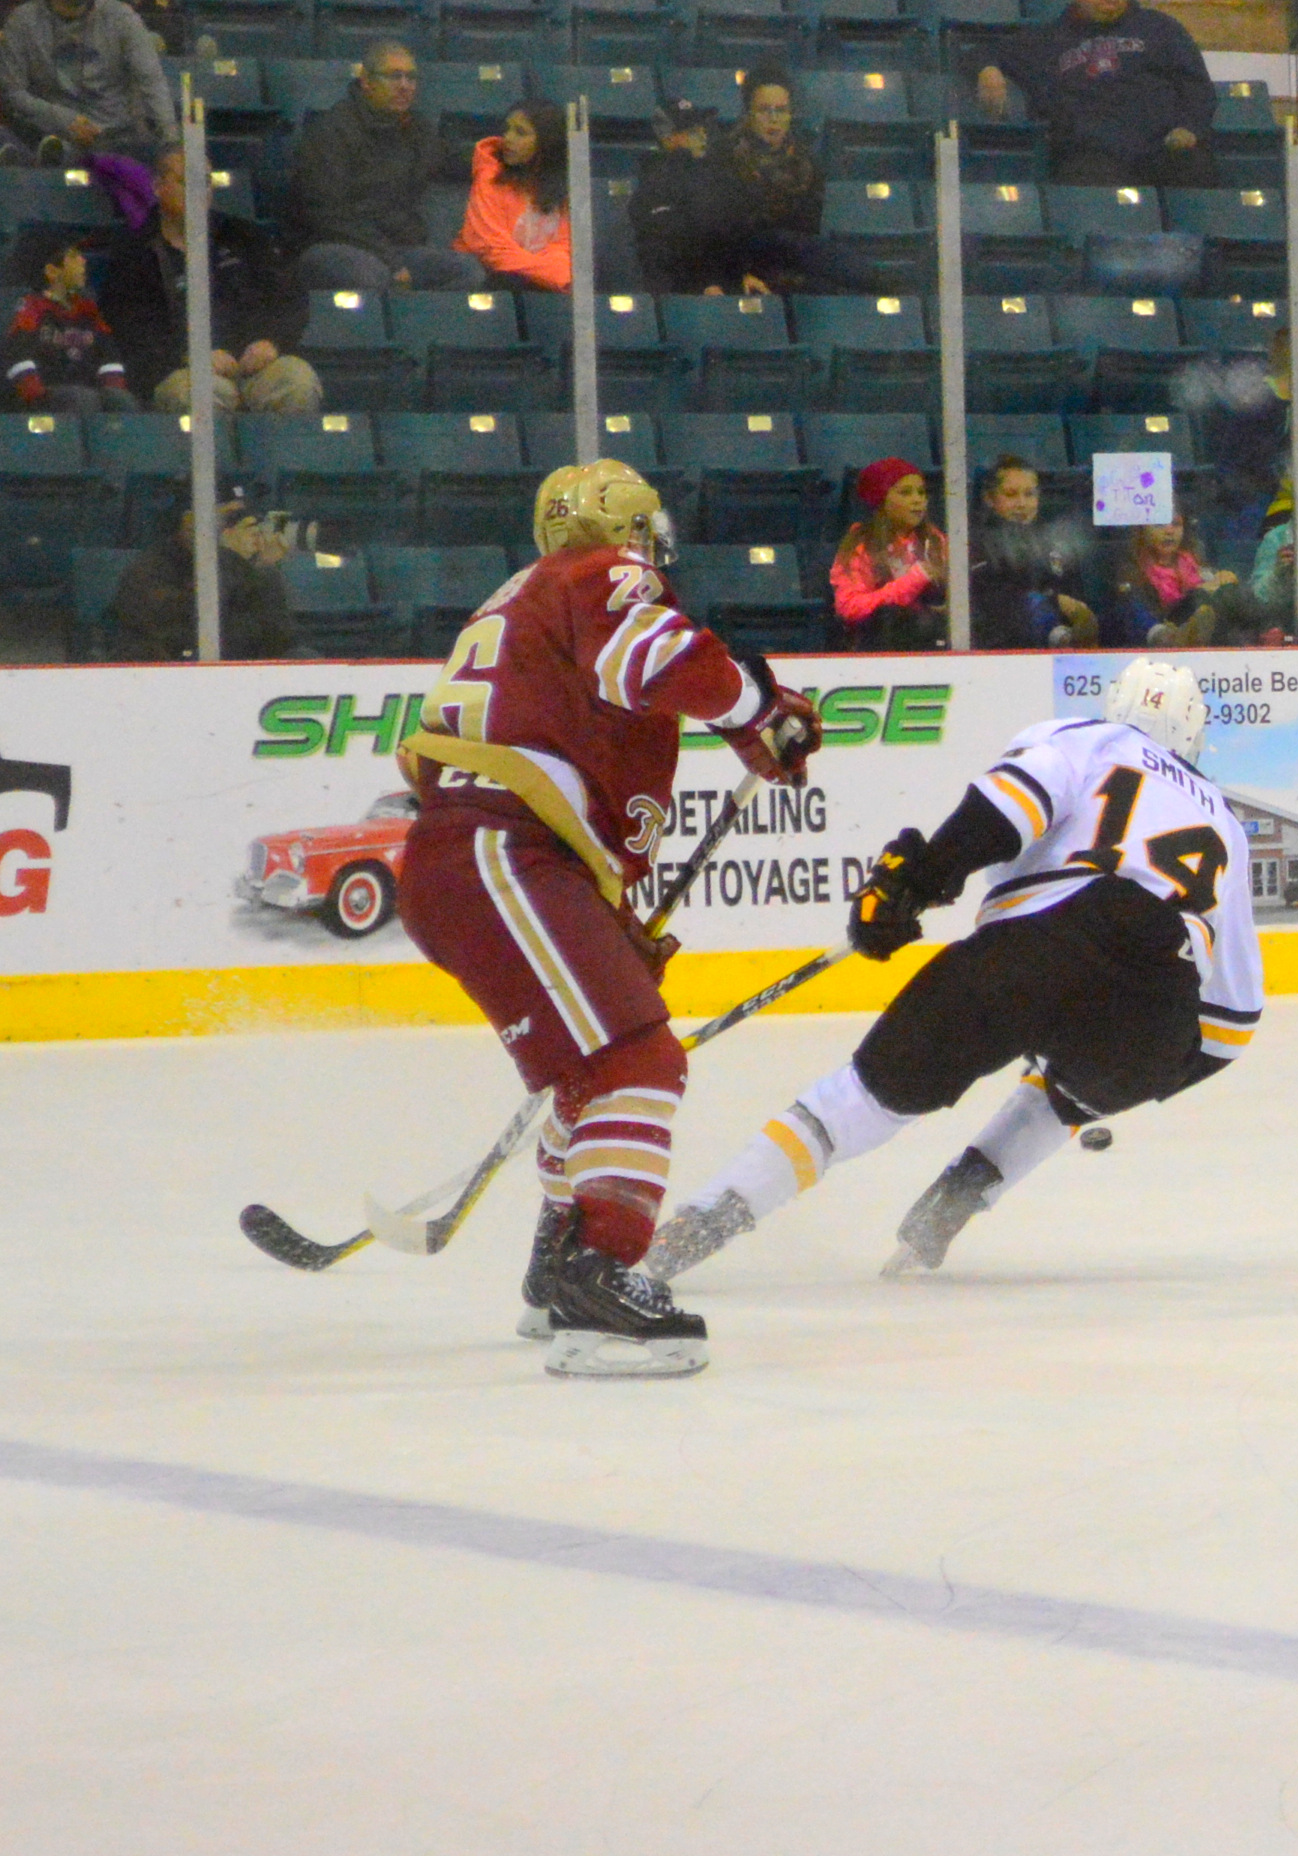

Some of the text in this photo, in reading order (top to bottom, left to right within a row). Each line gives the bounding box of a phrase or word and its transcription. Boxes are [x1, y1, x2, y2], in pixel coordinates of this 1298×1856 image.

[546, 498, 569, 518] 26
[1063, 675, 1102, 697] 625
[1197, 670, 1263, 700] cipale
[1143, 688, 1165, 709] 14
[1141, 746, 1216, 816] SMITH
[664, 786, 827, 838] DETAILING
[1063, 764, 1229, 915] 14
